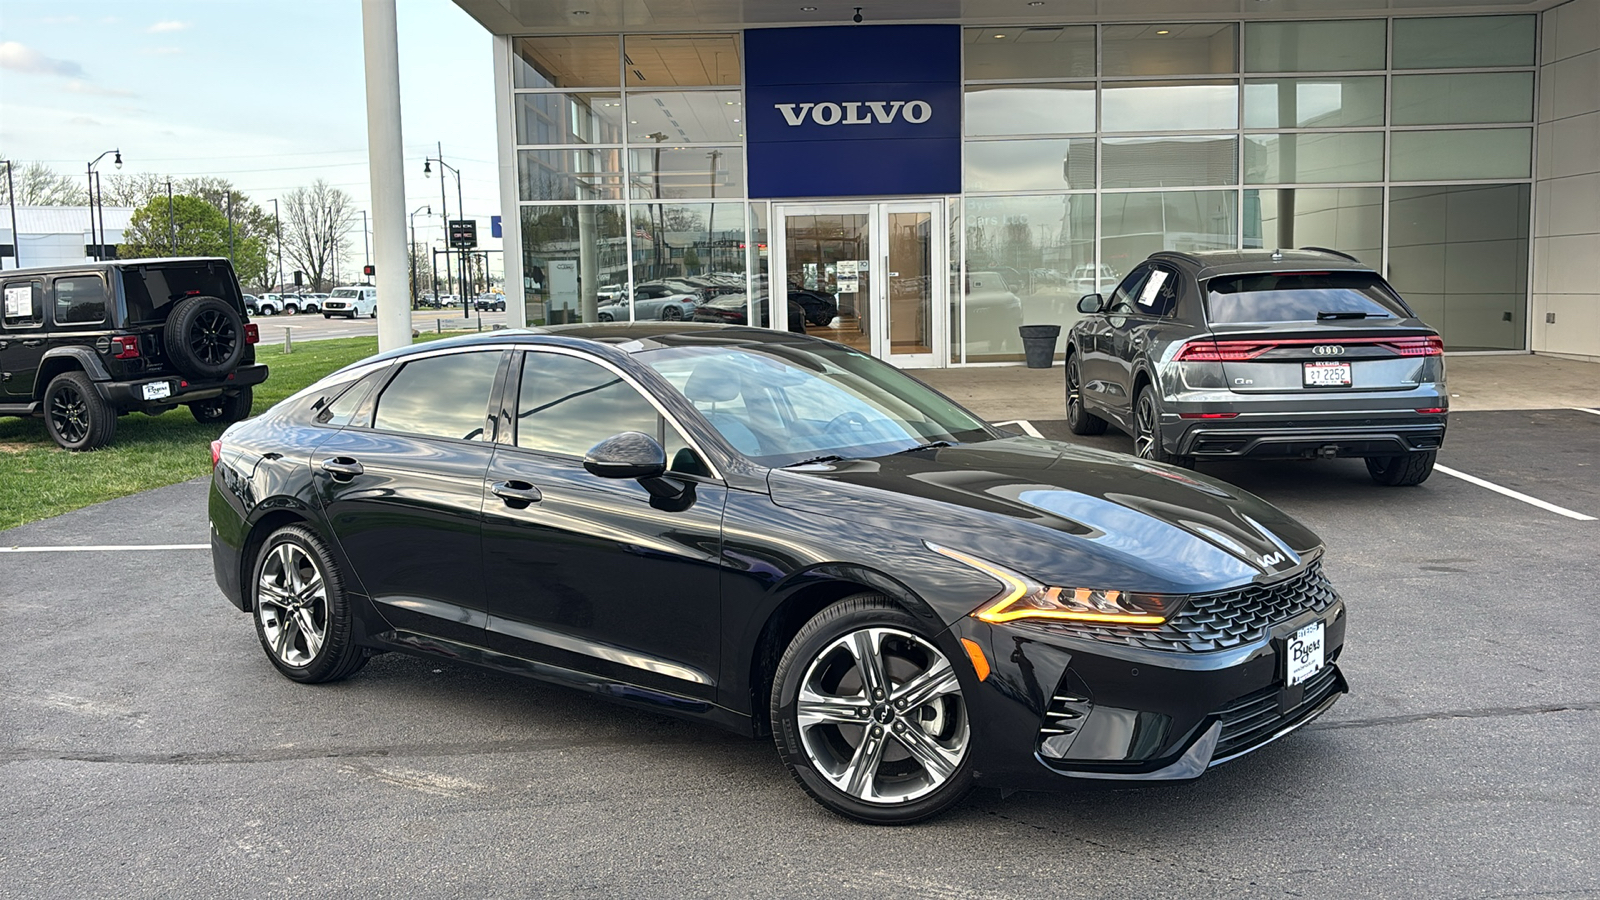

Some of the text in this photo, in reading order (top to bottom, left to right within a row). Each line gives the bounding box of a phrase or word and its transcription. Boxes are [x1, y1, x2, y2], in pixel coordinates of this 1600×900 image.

[775, 100, 932, 126] VOLVO
[967, 213, 998, 226] Cars
[1323, 368, 1346, 380] 2252
[1290, 640, 1320, 663] Byers
